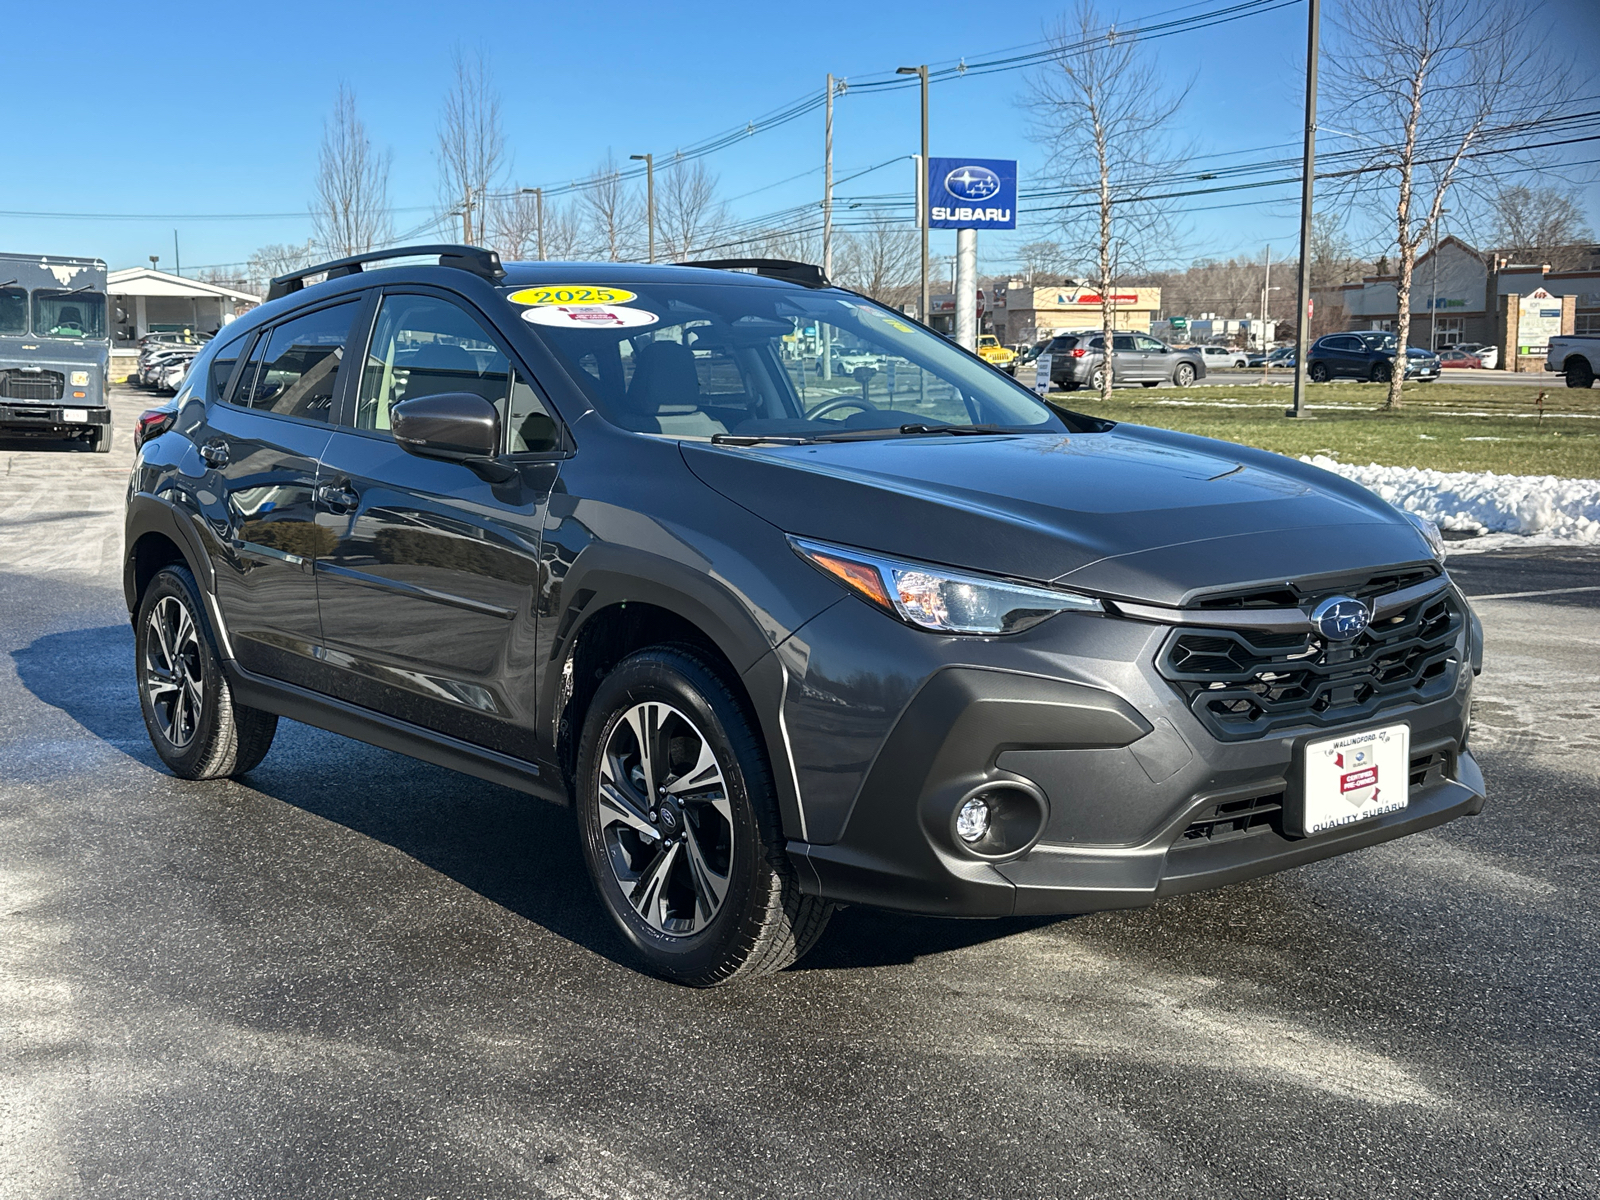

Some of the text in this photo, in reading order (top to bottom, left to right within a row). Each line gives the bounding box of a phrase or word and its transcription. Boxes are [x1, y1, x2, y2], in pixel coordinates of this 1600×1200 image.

[931, 207, 1011, 222] SUBARU
[534, 290, 614, 303] 2025
[1343, 776, 1376, 790] PRE-OWNED
[1346, 770, 1374, 783] CERTIFIED
[1312, 801, 1405, 833] QUALITY SUBARU
